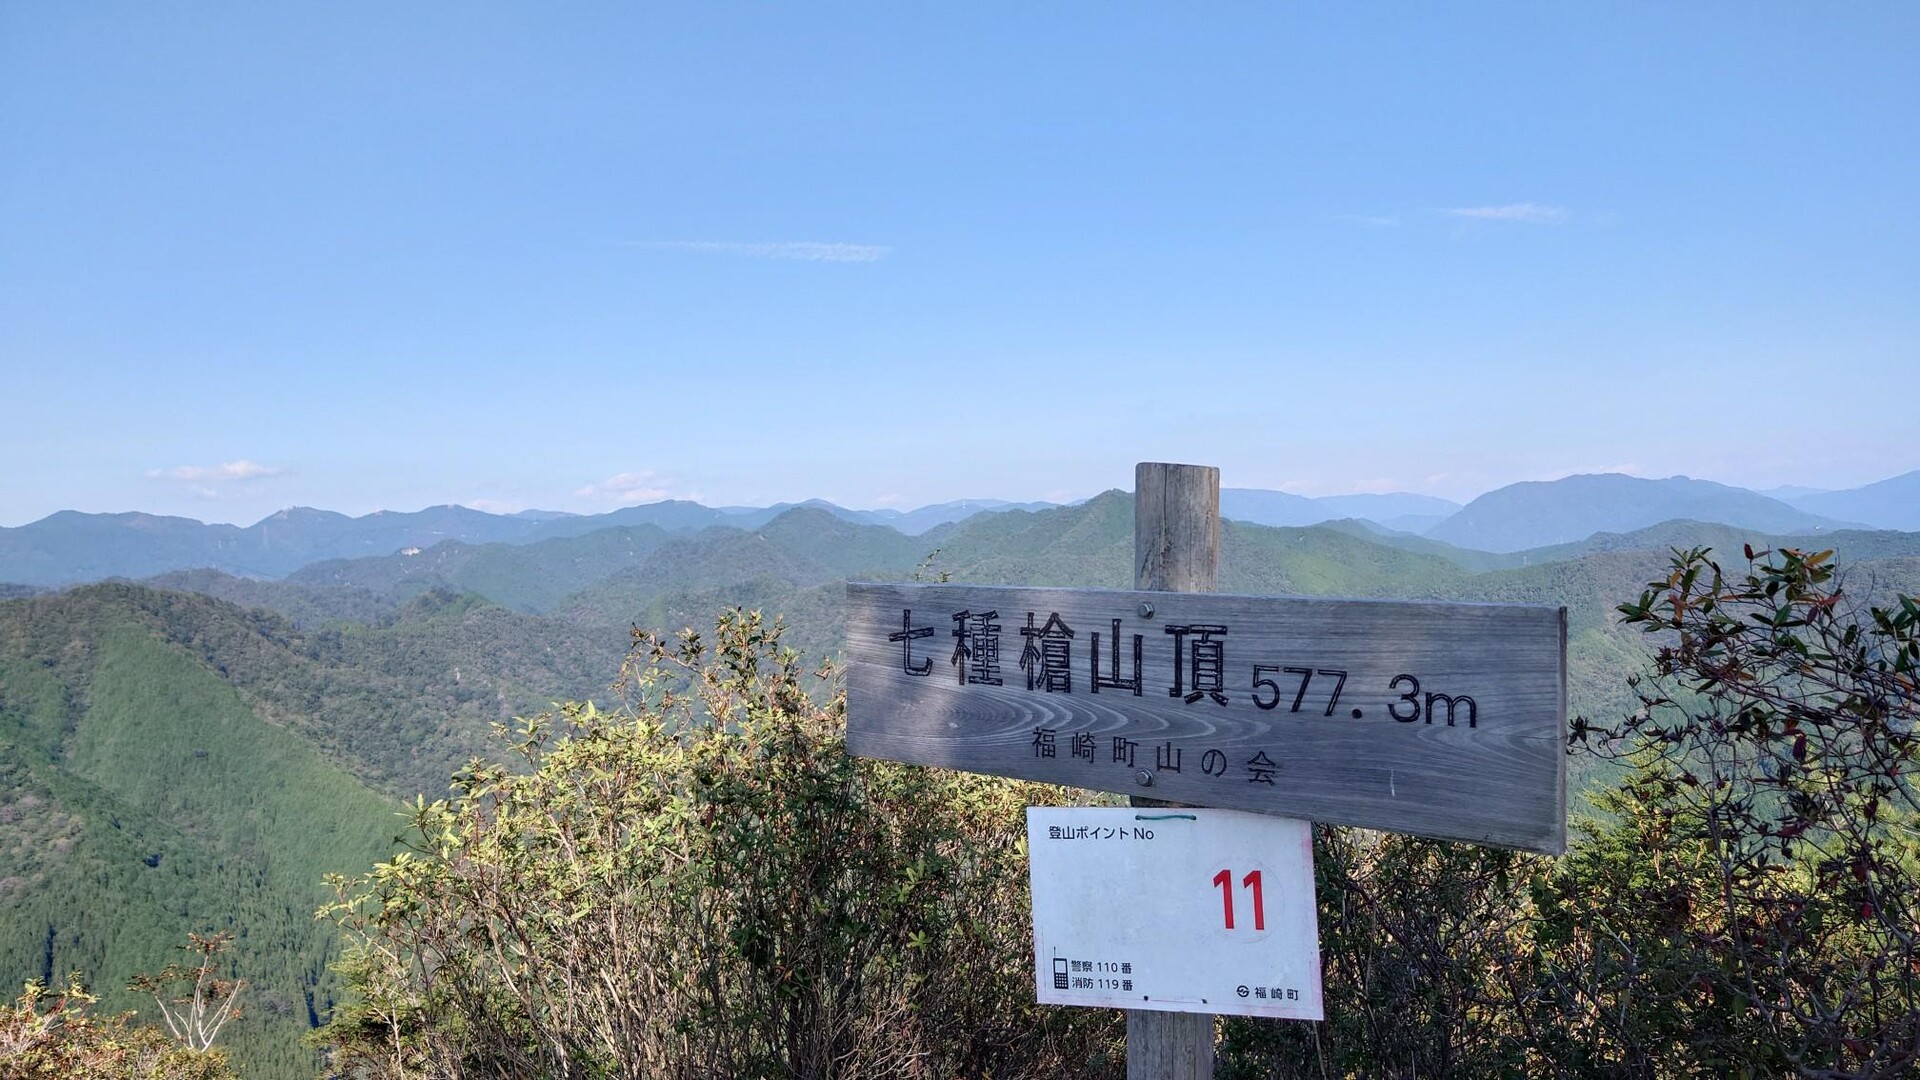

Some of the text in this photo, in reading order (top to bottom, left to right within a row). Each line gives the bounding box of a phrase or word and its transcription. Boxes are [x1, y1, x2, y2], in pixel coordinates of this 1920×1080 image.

[888, 607, 1228, 707] 七種槍山頂
[1032, 726, 1276, 786] 福崎町山の会
[1213, 869, 1265, 930] 11
[1254, 986, 1299, 1001] 福崎町
